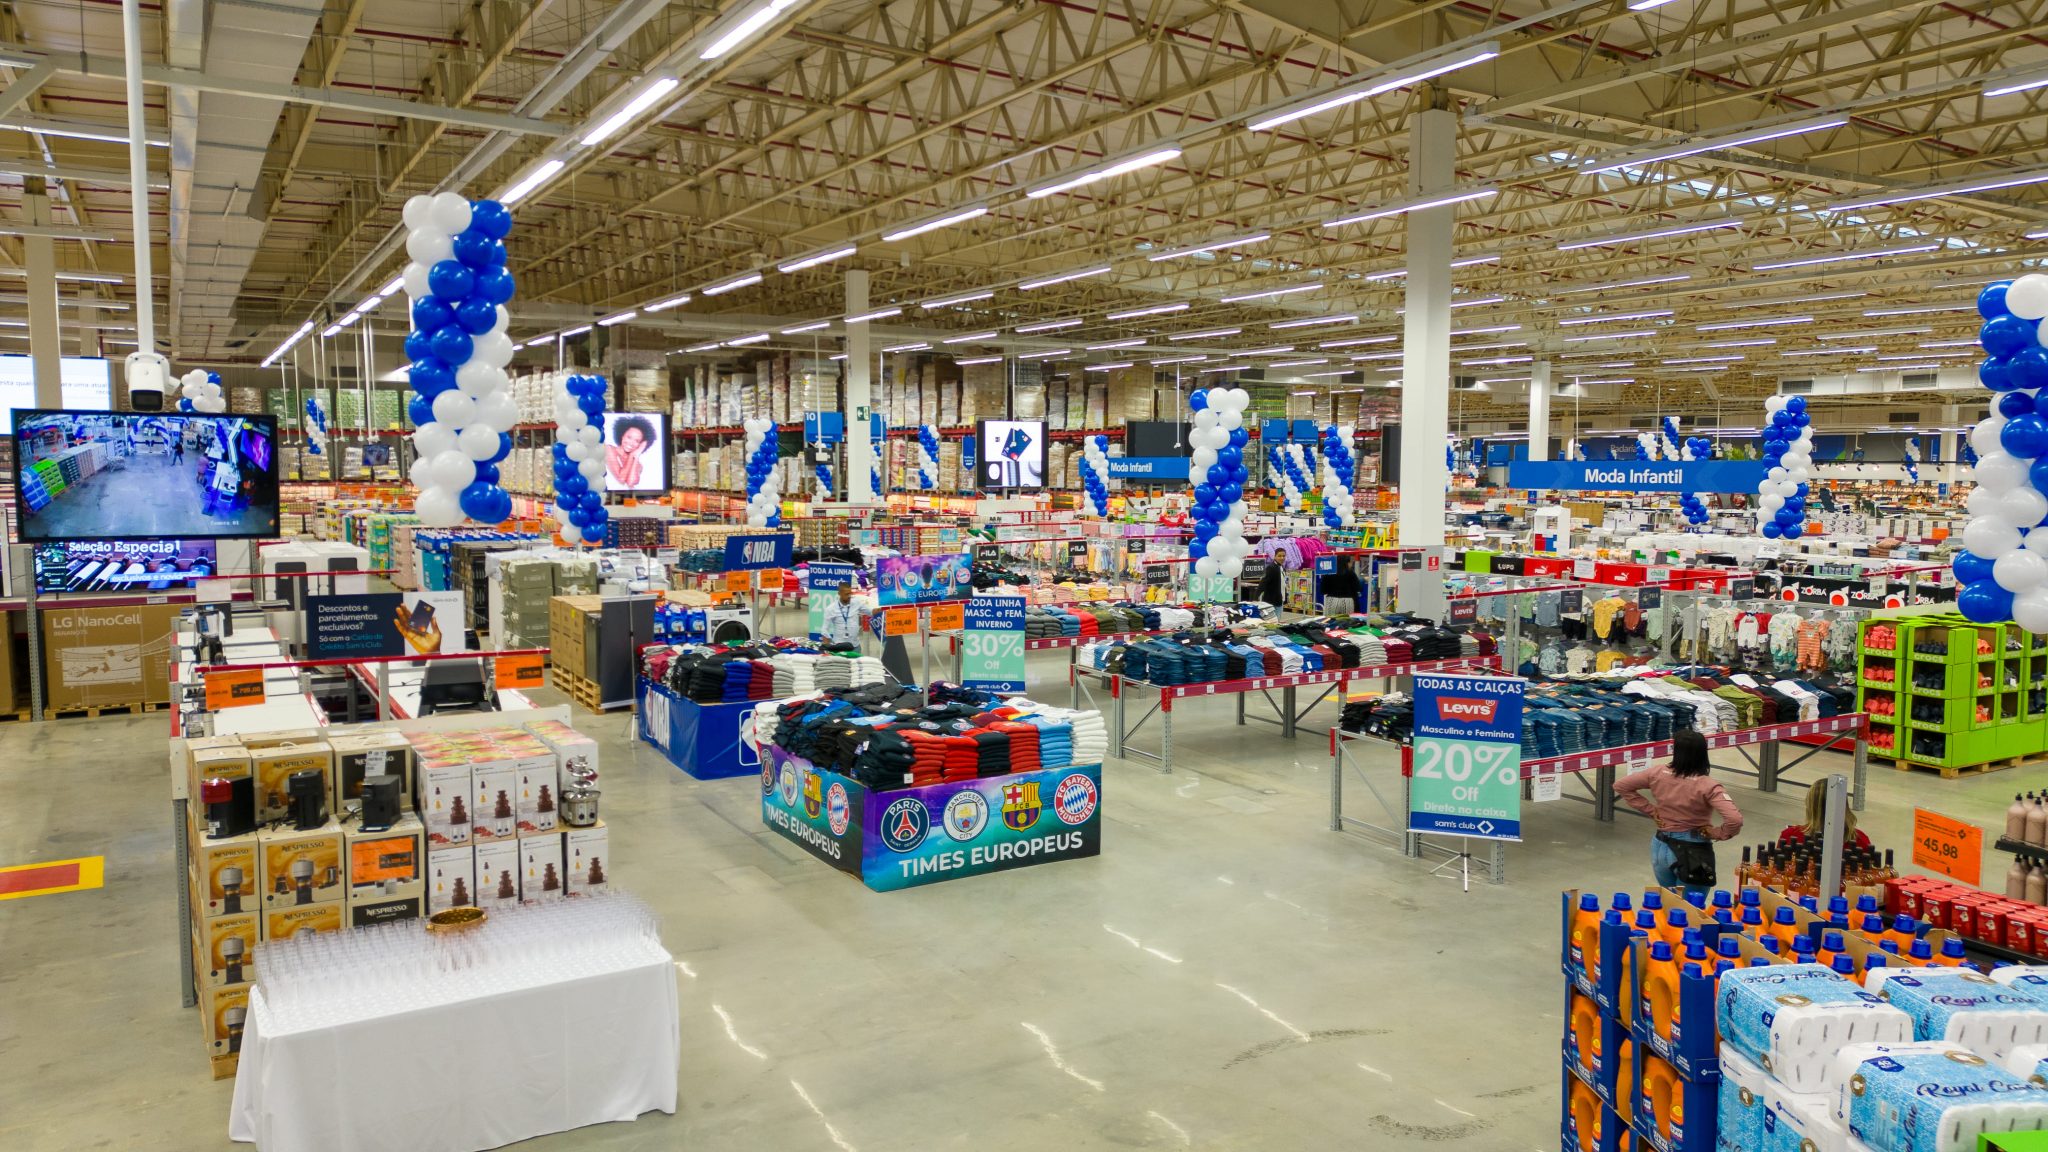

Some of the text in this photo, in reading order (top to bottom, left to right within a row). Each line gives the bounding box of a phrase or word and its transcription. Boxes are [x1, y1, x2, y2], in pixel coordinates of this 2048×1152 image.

[806, 412, 816, 421] 10
[1110, 462, 1152, 472] Moda Infantil
[1585, 468, 1682, 484] Moda Infantil
[69, 540, 181, 555] Seleção Especial
[752, 541, 776, 563] NBA
[1148, 570, 1169, 578] GUESS
[1192, 577, 1232, 594] 30%
[968, 598, 992, 606] TODA
[318, 604, 360, 612] Descontos
[52, 612, 141, 628] LG NanoCell
[318, 614, 378, 623] parcelamentos
[318, 622, 364, 631] exclusivos?
[966, 634, 1024, 657] 30%
[1864, 648, 1892, 656] crocs
[1914, 654, 1943, 662] crocs
[984, 660, 1000, 670] Off
[1418, 678, 1522, 696] TODAS AS CALÇAS
[1864, 680, 1892, 688] crocs
[1912, 686, 1940, 696] crocs
[1869, 712, 1891, 722] rocs
[1912, 720, 1940, 731] crocs
[1421, 725, 1464, 736] Masculino
[1475, 730, 1514, 738] Feminina
[1868, 746, 1890, 756] rocs
[273, 760, 314, 768] NESPRESSO
[1416, 741, 1517, 785] 20%
[1912, 753, 1941, 764] crocs
[1057, 777, 1094, 798] FC BAYERN
[1452, 786, 1478, 801] Off
[947, 792, 984, 812] MANCHESTER
[889, 801, 920, 816] PARIS
[1475, 807, 1506, 818] caixa
[764, 801, 841, 860] TIMES EUROPEUS
[1434, 820, 1476, 830] sam's club
[282, 841, 324, 852] NESPRESSO
[1924, 838, 1958, 859] 45,98
[898, 832, 1083, 878] TIMES EUROPEUS
[366, 904, 408, 917] NESPRESSO
[1931, 994, 1989, 1006] Royal
[1916, 1082, 1984, 1098] Royal
[1903, 1104, 1918, 1138] Care
